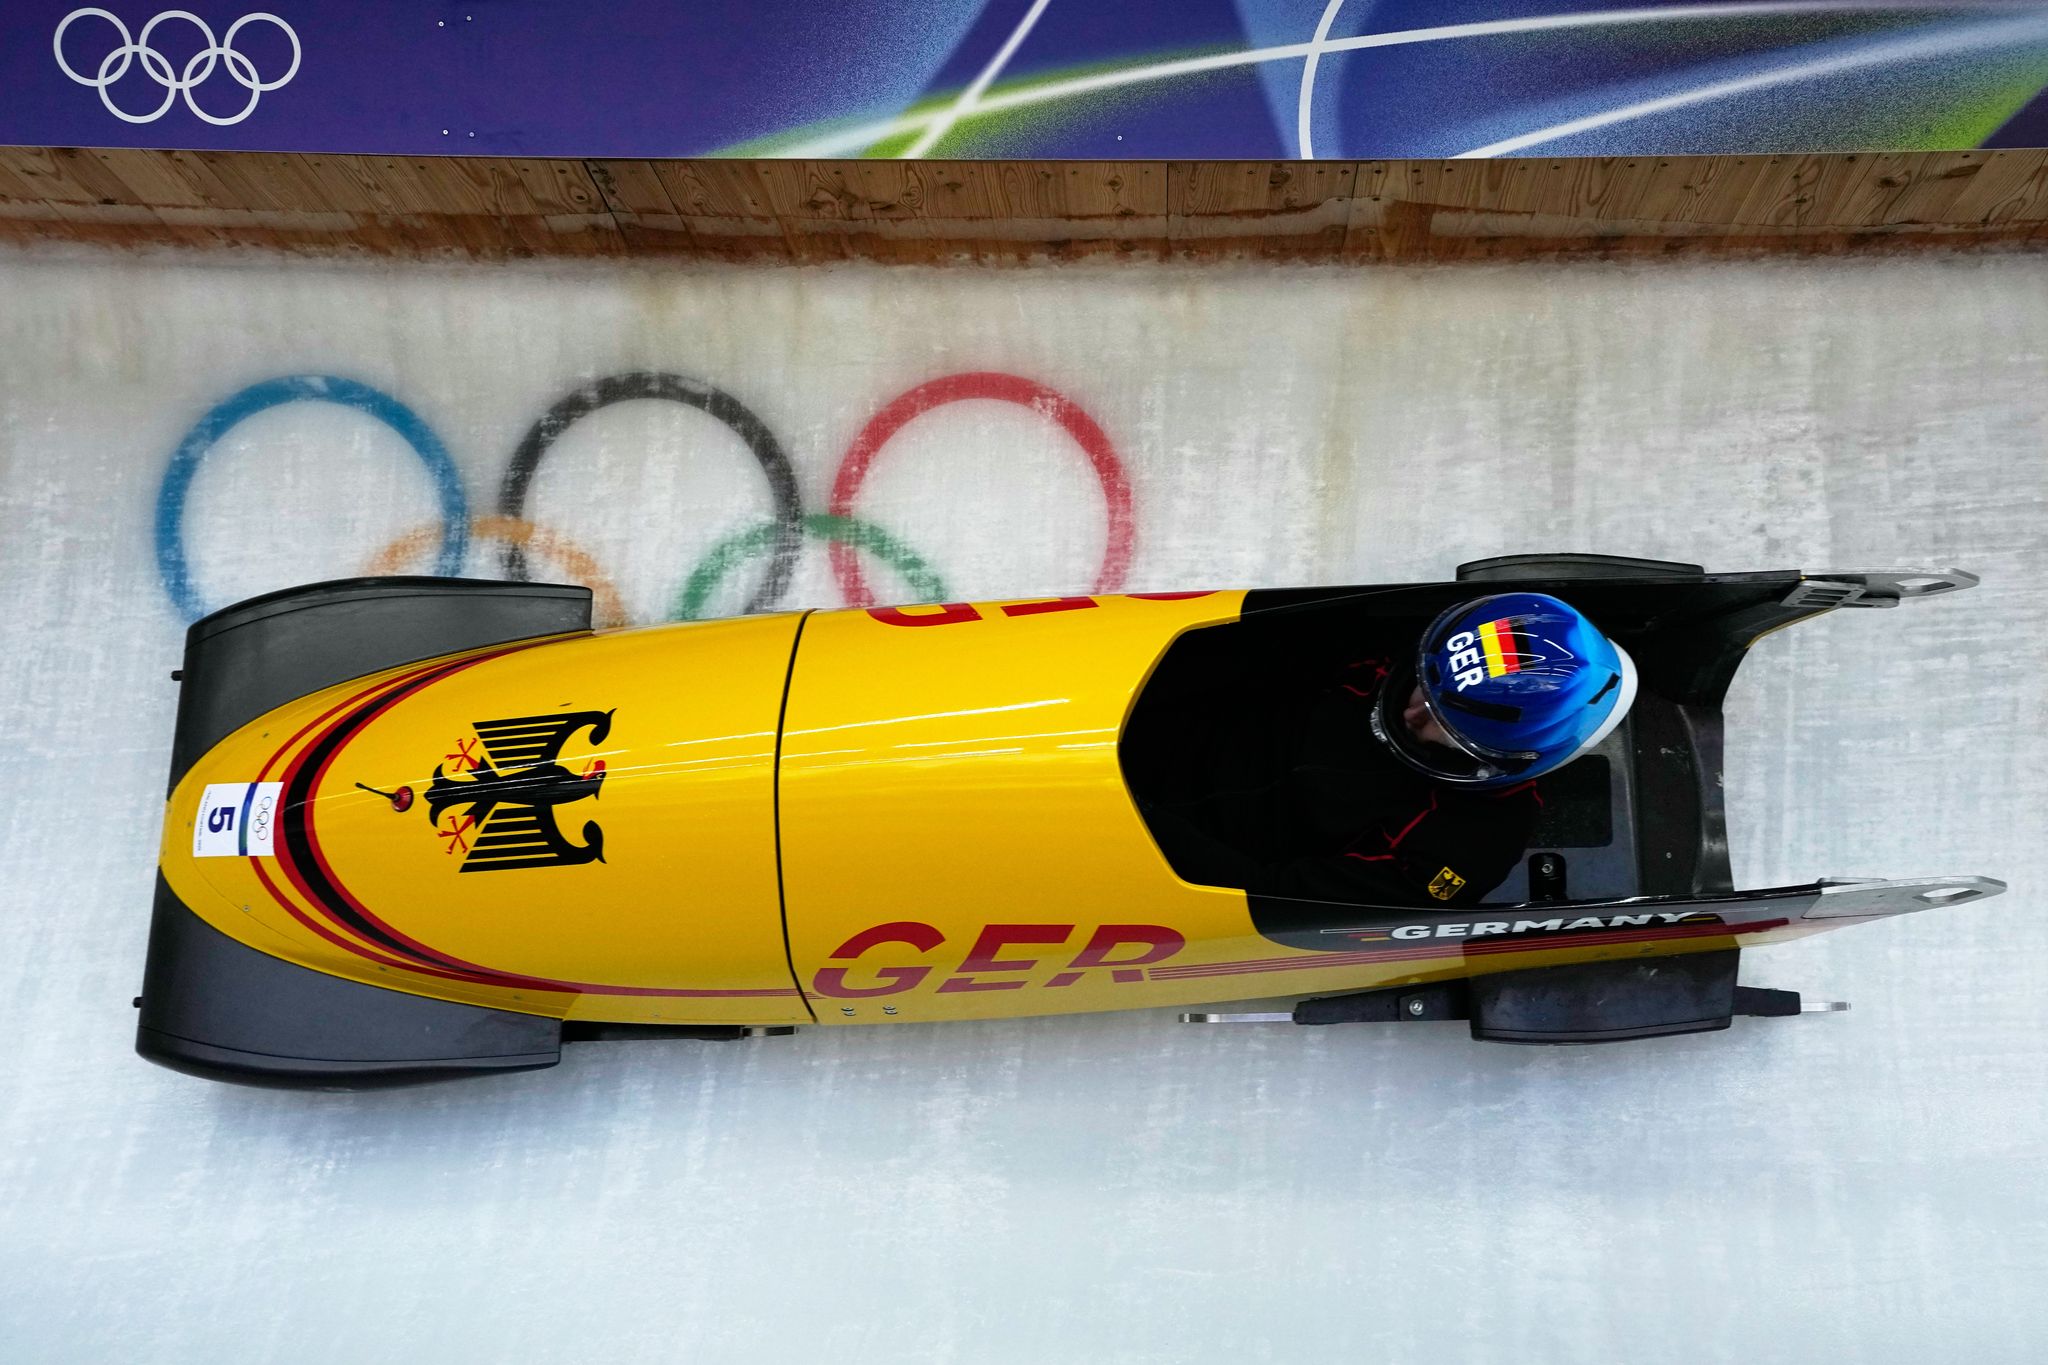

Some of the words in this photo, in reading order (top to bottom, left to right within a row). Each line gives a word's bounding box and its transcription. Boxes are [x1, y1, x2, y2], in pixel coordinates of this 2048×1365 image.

[1447, 632, 1484, 692] GER
[208, 807, 236, 833] 5
[1392, 912, 1698, 940] GERMANY
[813, 922, 1185, 998] GER
